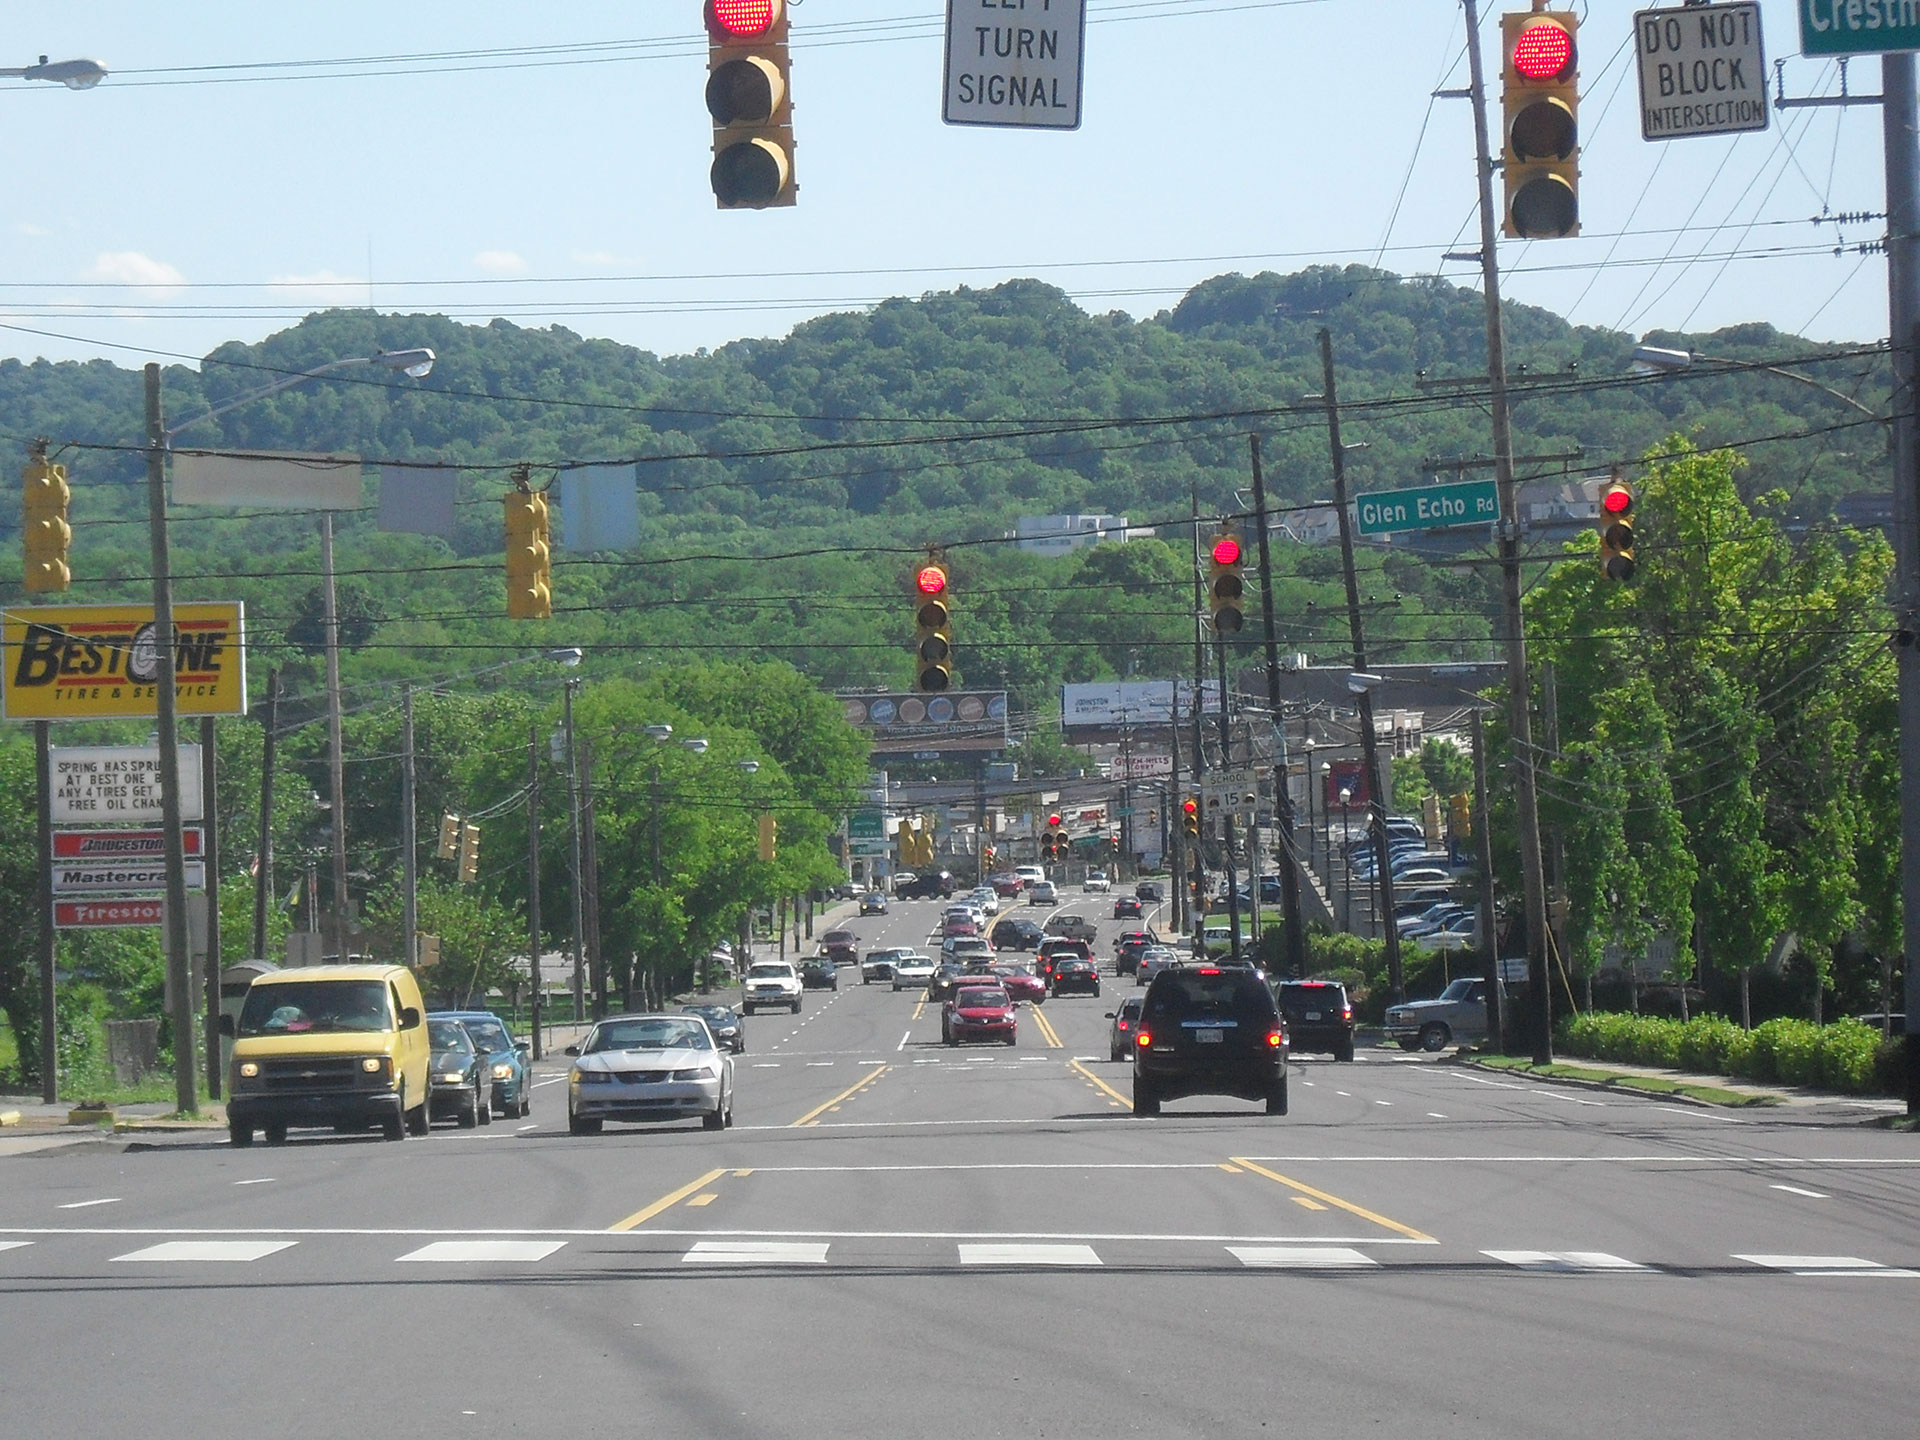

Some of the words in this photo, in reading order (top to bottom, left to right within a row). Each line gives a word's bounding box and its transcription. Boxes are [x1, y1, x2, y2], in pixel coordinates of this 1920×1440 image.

[1644, 18, 1681, 54] DO
[1700, 12, 1750, 49] NOT
[975, 27, 1058, 60] TURN
[1658, 58, 1746, 97] BLOCK
[958, 73, 1067, 108] SIGNAL
[1647, 100, 1763, 131] INTERSECTION
[1363, 503, 1407, 525] Glen
[1417, 497, 1466, 519] Echo
[1477, 497, 1494, 513] Rd
[55, 688, 99, 700] TIRE
[112, 688, 120, 698] &
[133, 685, 217, 698] SEVICE
[58, 762, 97, 773] SPRING
[105, 762, 127, 772] HAS
[131, 761, 161, 772] SPRU
[66, 775, 81, 786] AT
[90, 774, 118, 785] BEST
[124, 774, 145, 784] ONE
[1210, 773, 1248, 784] SCHOOL
[58, 788, 81, 798] ANY
[86, 788, 92, 798] 4
[96, 787, 127, 797] TIRES
[133, 786, 153, 796] GET
[1225, 792, 1239, 805] 15
[69, 800, 97, 810] FREE
[107, 800, 126, 809] OIL
[132, 799, 162, 809] CHAN
[82, 839, 166, 851] BRIDGESTON
[63, 871, 167, 883] Mastercra
[75, 906, 162, 921] Firesto
